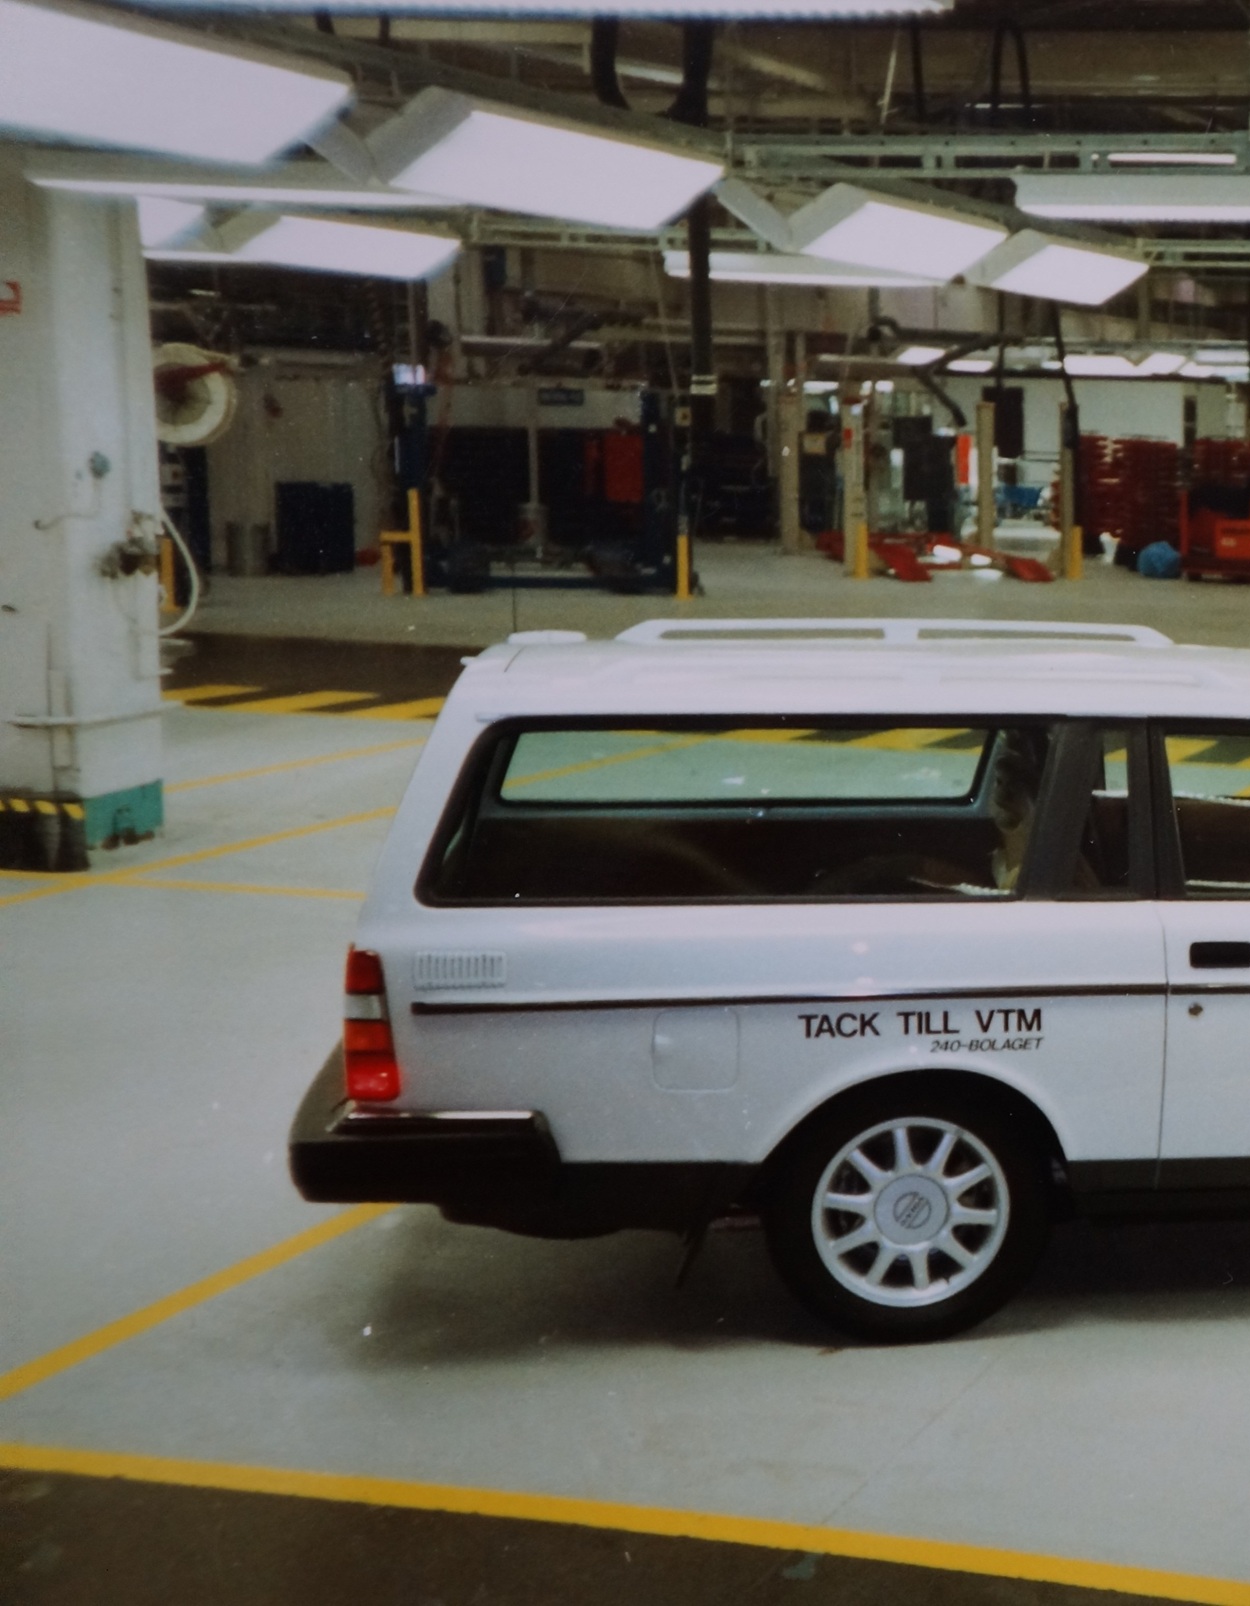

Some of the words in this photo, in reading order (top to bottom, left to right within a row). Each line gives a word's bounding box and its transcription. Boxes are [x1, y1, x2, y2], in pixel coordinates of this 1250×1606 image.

[798, 1012, 881, 1038] TACK
[896, 1010, 960, 1035] TILL
[975, 1008, 1043, 1033] VTM
[930, 1037, 1044, 1053] 240-BOLAGET
